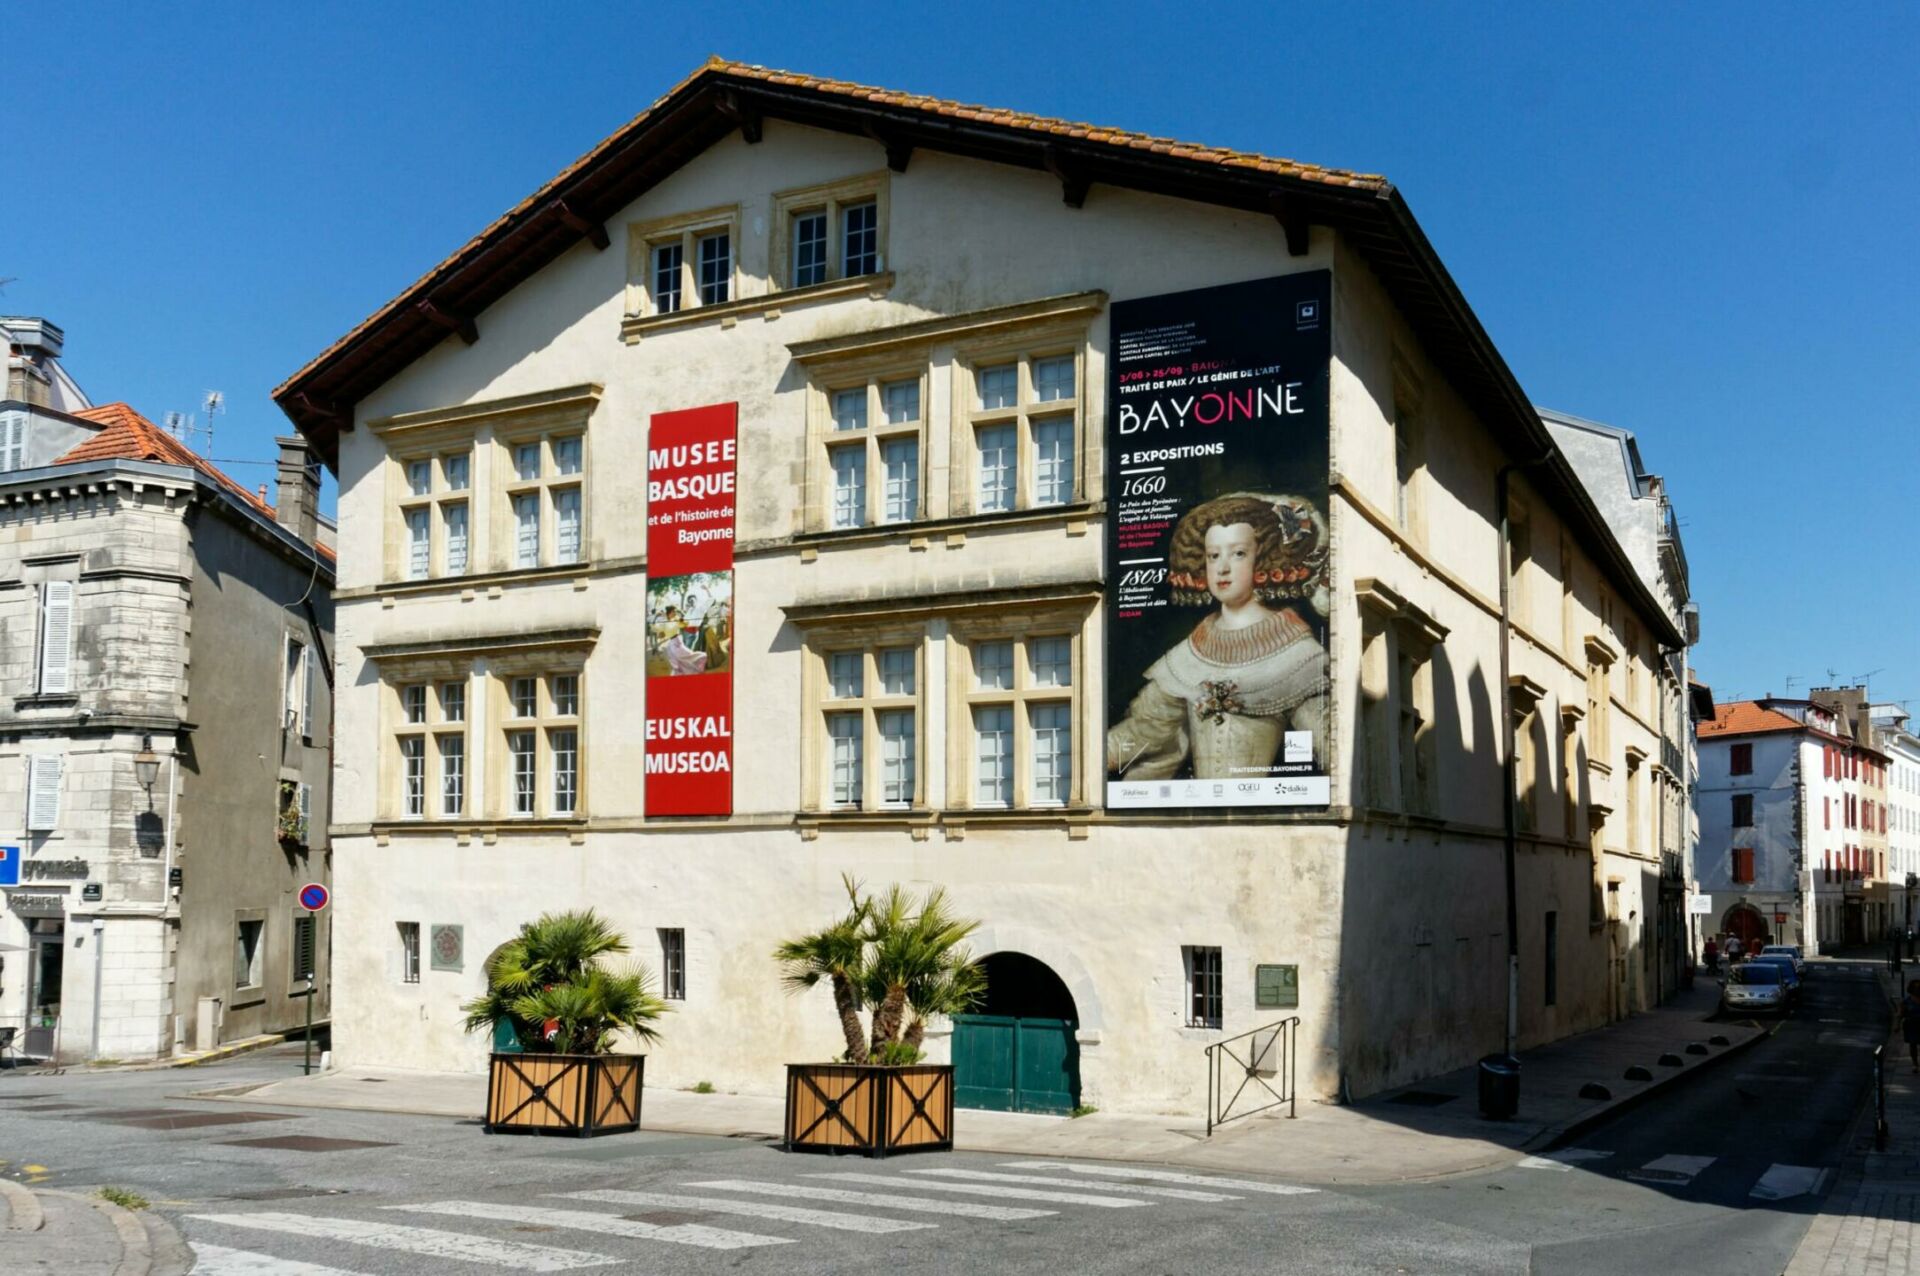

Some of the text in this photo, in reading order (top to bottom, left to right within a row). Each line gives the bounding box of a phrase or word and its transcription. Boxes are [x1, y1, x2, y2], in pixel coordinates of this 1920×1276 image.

[1120, 371, 1143, 382] 3/06
[1153, 366, 1182, 378] 25/09
[1120, 382, 1150, 394] TRAITÉ
[1153, 380, 1164, 390] DE
[1166, 378, 1187, 388] PAIX
[1198, 374, 1208, 383] LE
[1211, 370, 1238, 382] GÉNIE
[1240, 369, 1252, 378] DE
[1255, 366, 1280, 376] L'ART
[1120, 382, 1304, 434] BAYONNE
[648, 439, 736, 471] MUSEE
[1120, 442, 1224, 465] 2 EXPOSITIONS
[648, 472, 735, 502] BASQUE
[1122, 476, 1166, 496] 1660
[648, 506, 734, 526] et de l'histoire de
[678, 527, 733, 546] Bayonne
[1119, 568, 1168, 586] 1808
[645, 716, 731, 740] EUSKAL
[645, 751, 730, 774] MUSEOA
[22, 856, 88, 881] yonnais
